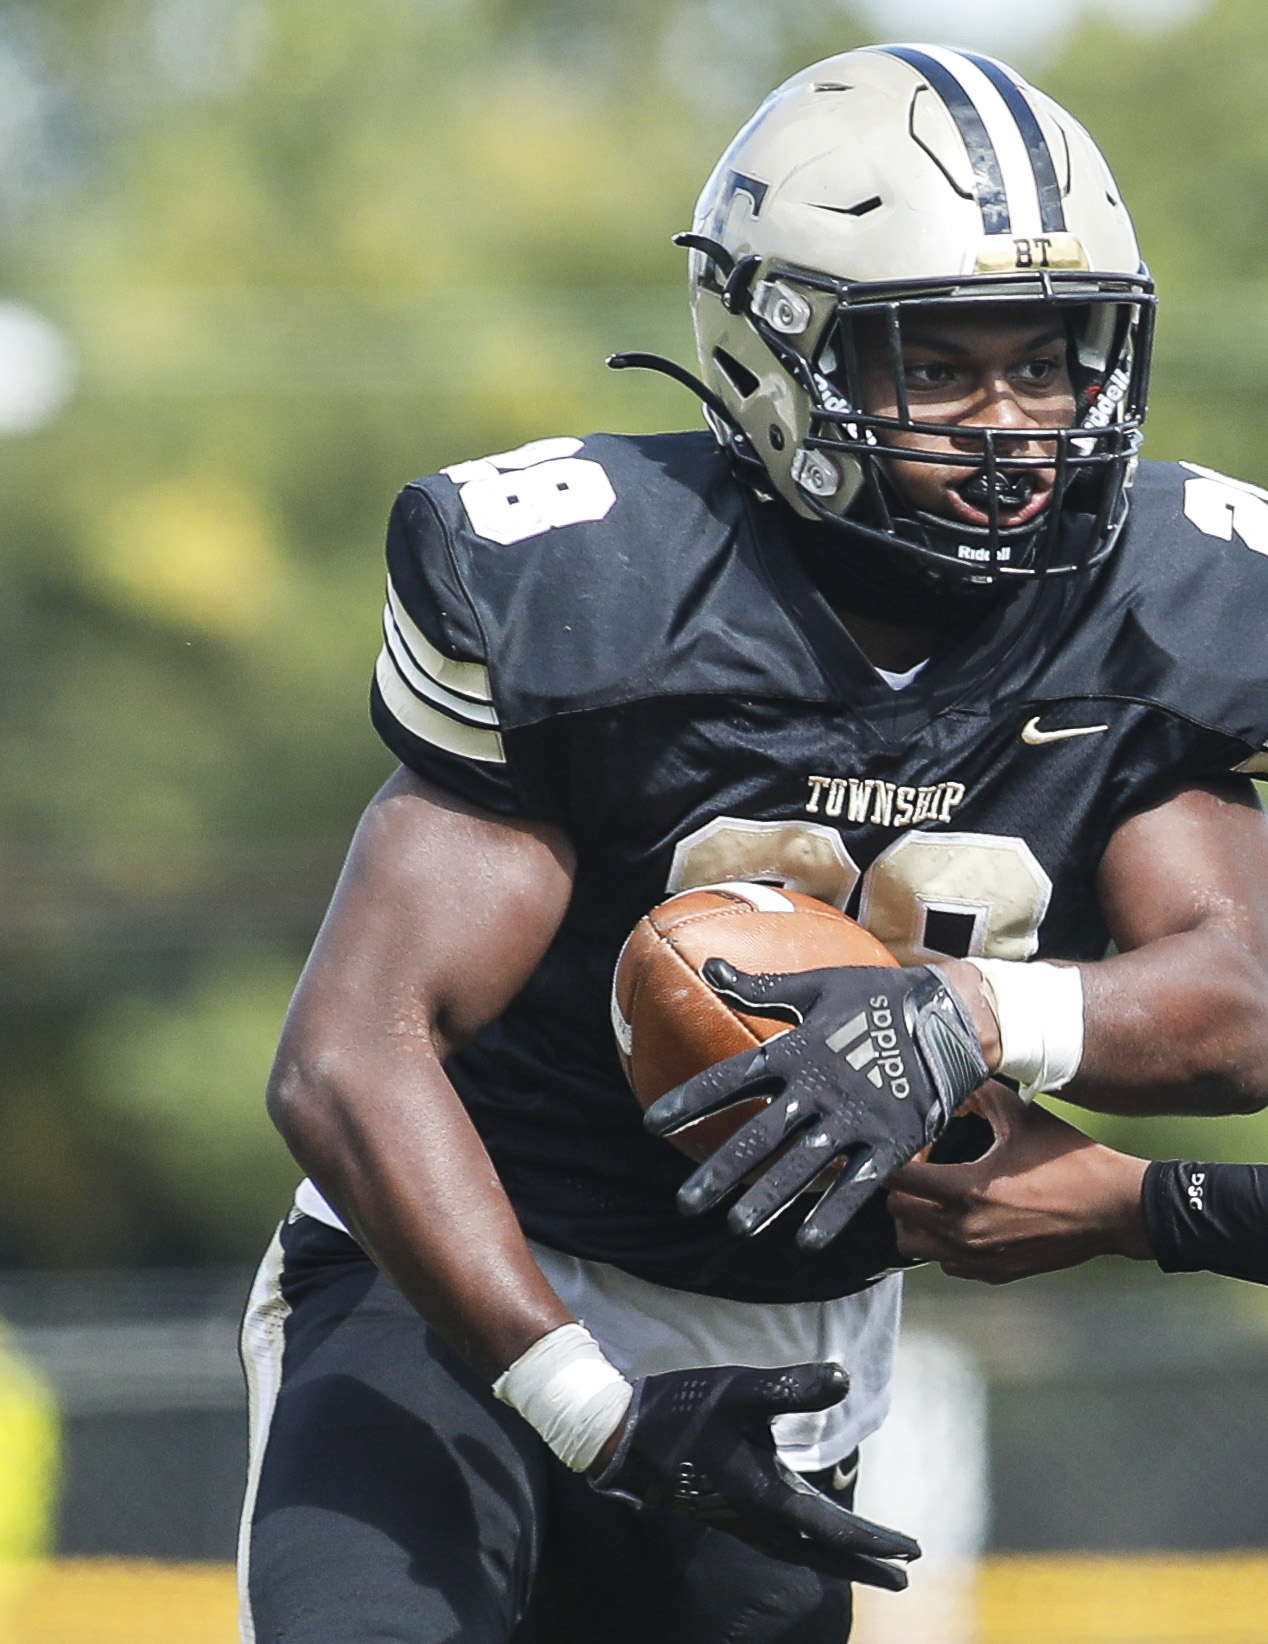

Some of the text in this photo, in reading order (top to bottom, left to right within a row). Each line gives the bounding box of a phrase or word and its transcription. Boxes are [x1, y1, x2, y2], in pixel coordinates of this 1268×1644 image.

[1012, 237, 1053, 268] BT
[804, 775, 966, 827] TOWNSHIP
[870, 994, 910, 1099] adidas
